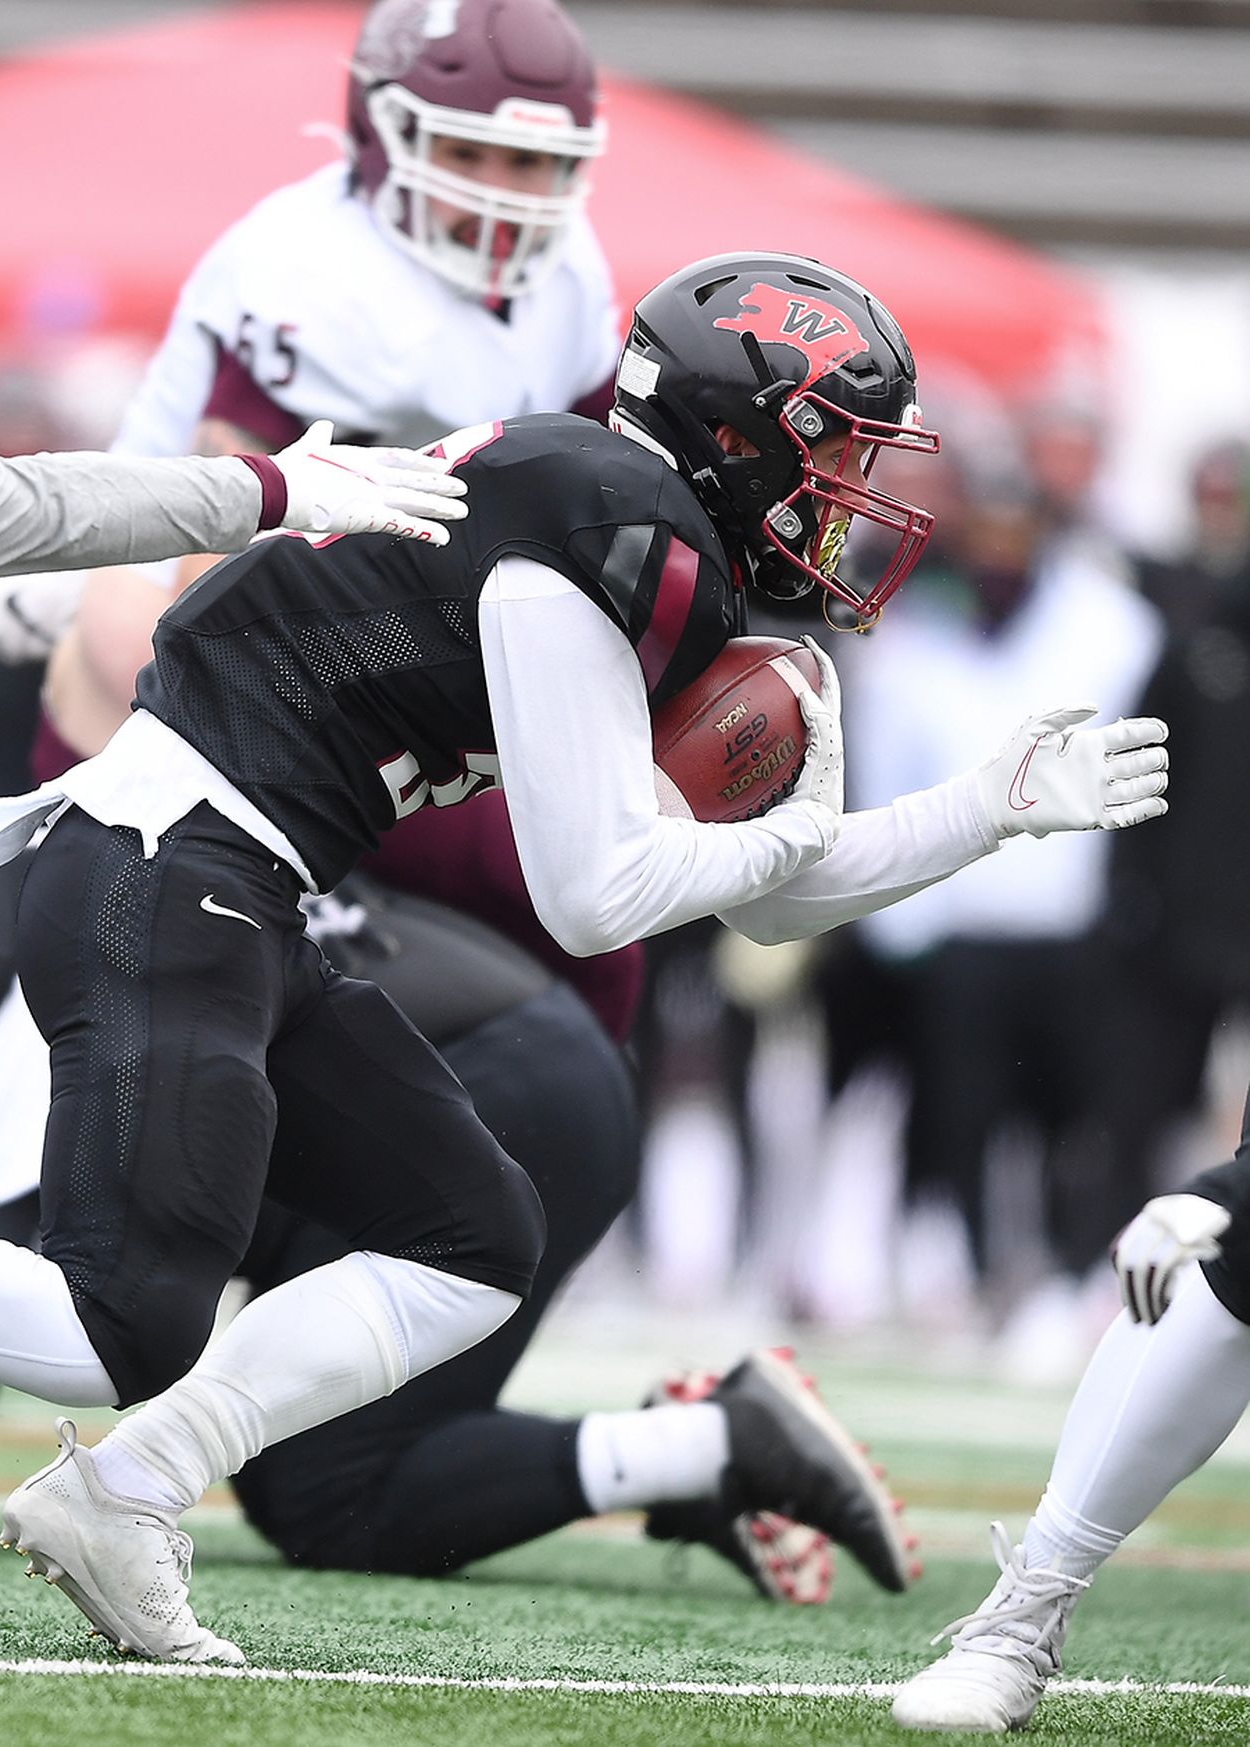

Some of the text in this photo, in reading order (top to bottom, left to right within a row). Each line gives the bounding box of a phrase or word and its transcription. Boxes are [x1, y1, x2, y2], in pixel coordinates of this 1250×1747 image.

[780, 300, 848, 345] W
[714, 702, 749, 734] NCAA
[723, 713, 768, 765] GST
[720, 735, 798, 802] Wilson
